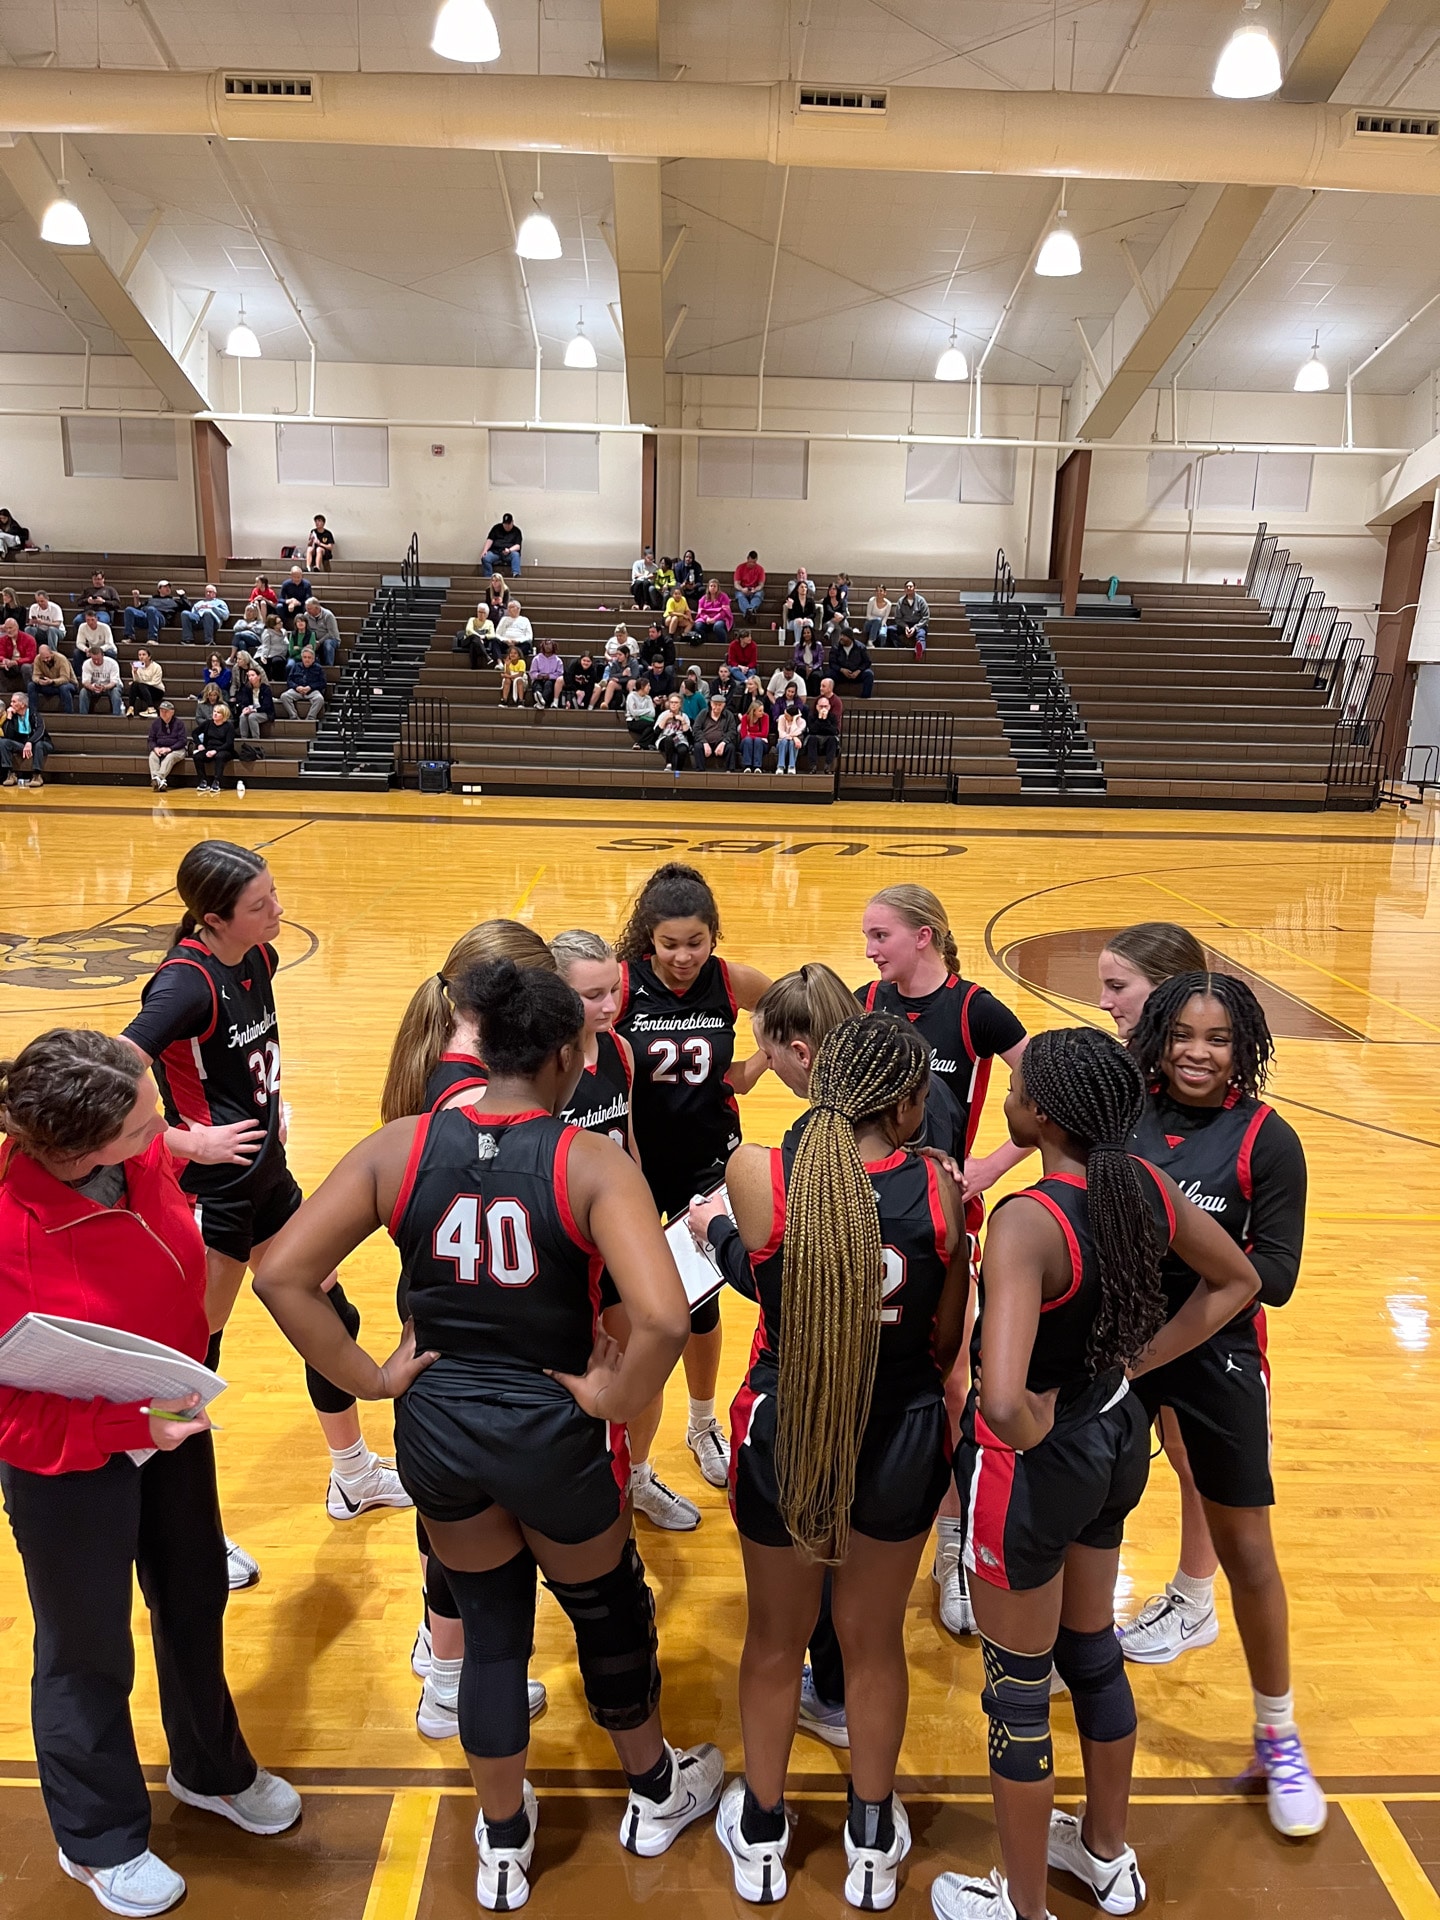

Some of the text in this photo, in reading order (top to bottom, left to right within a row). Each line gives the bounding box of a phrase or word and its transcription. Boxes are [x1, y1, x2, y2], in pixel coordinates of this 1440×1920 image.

[596, 838, 969, 857] CUBS
[630, 1011, 725, 1032] Fontainebleau
[247, 1038, 280, 1107] 32
[647, 1036, 713, 1086] 23
[432, 1193, 539, 1288] 40
